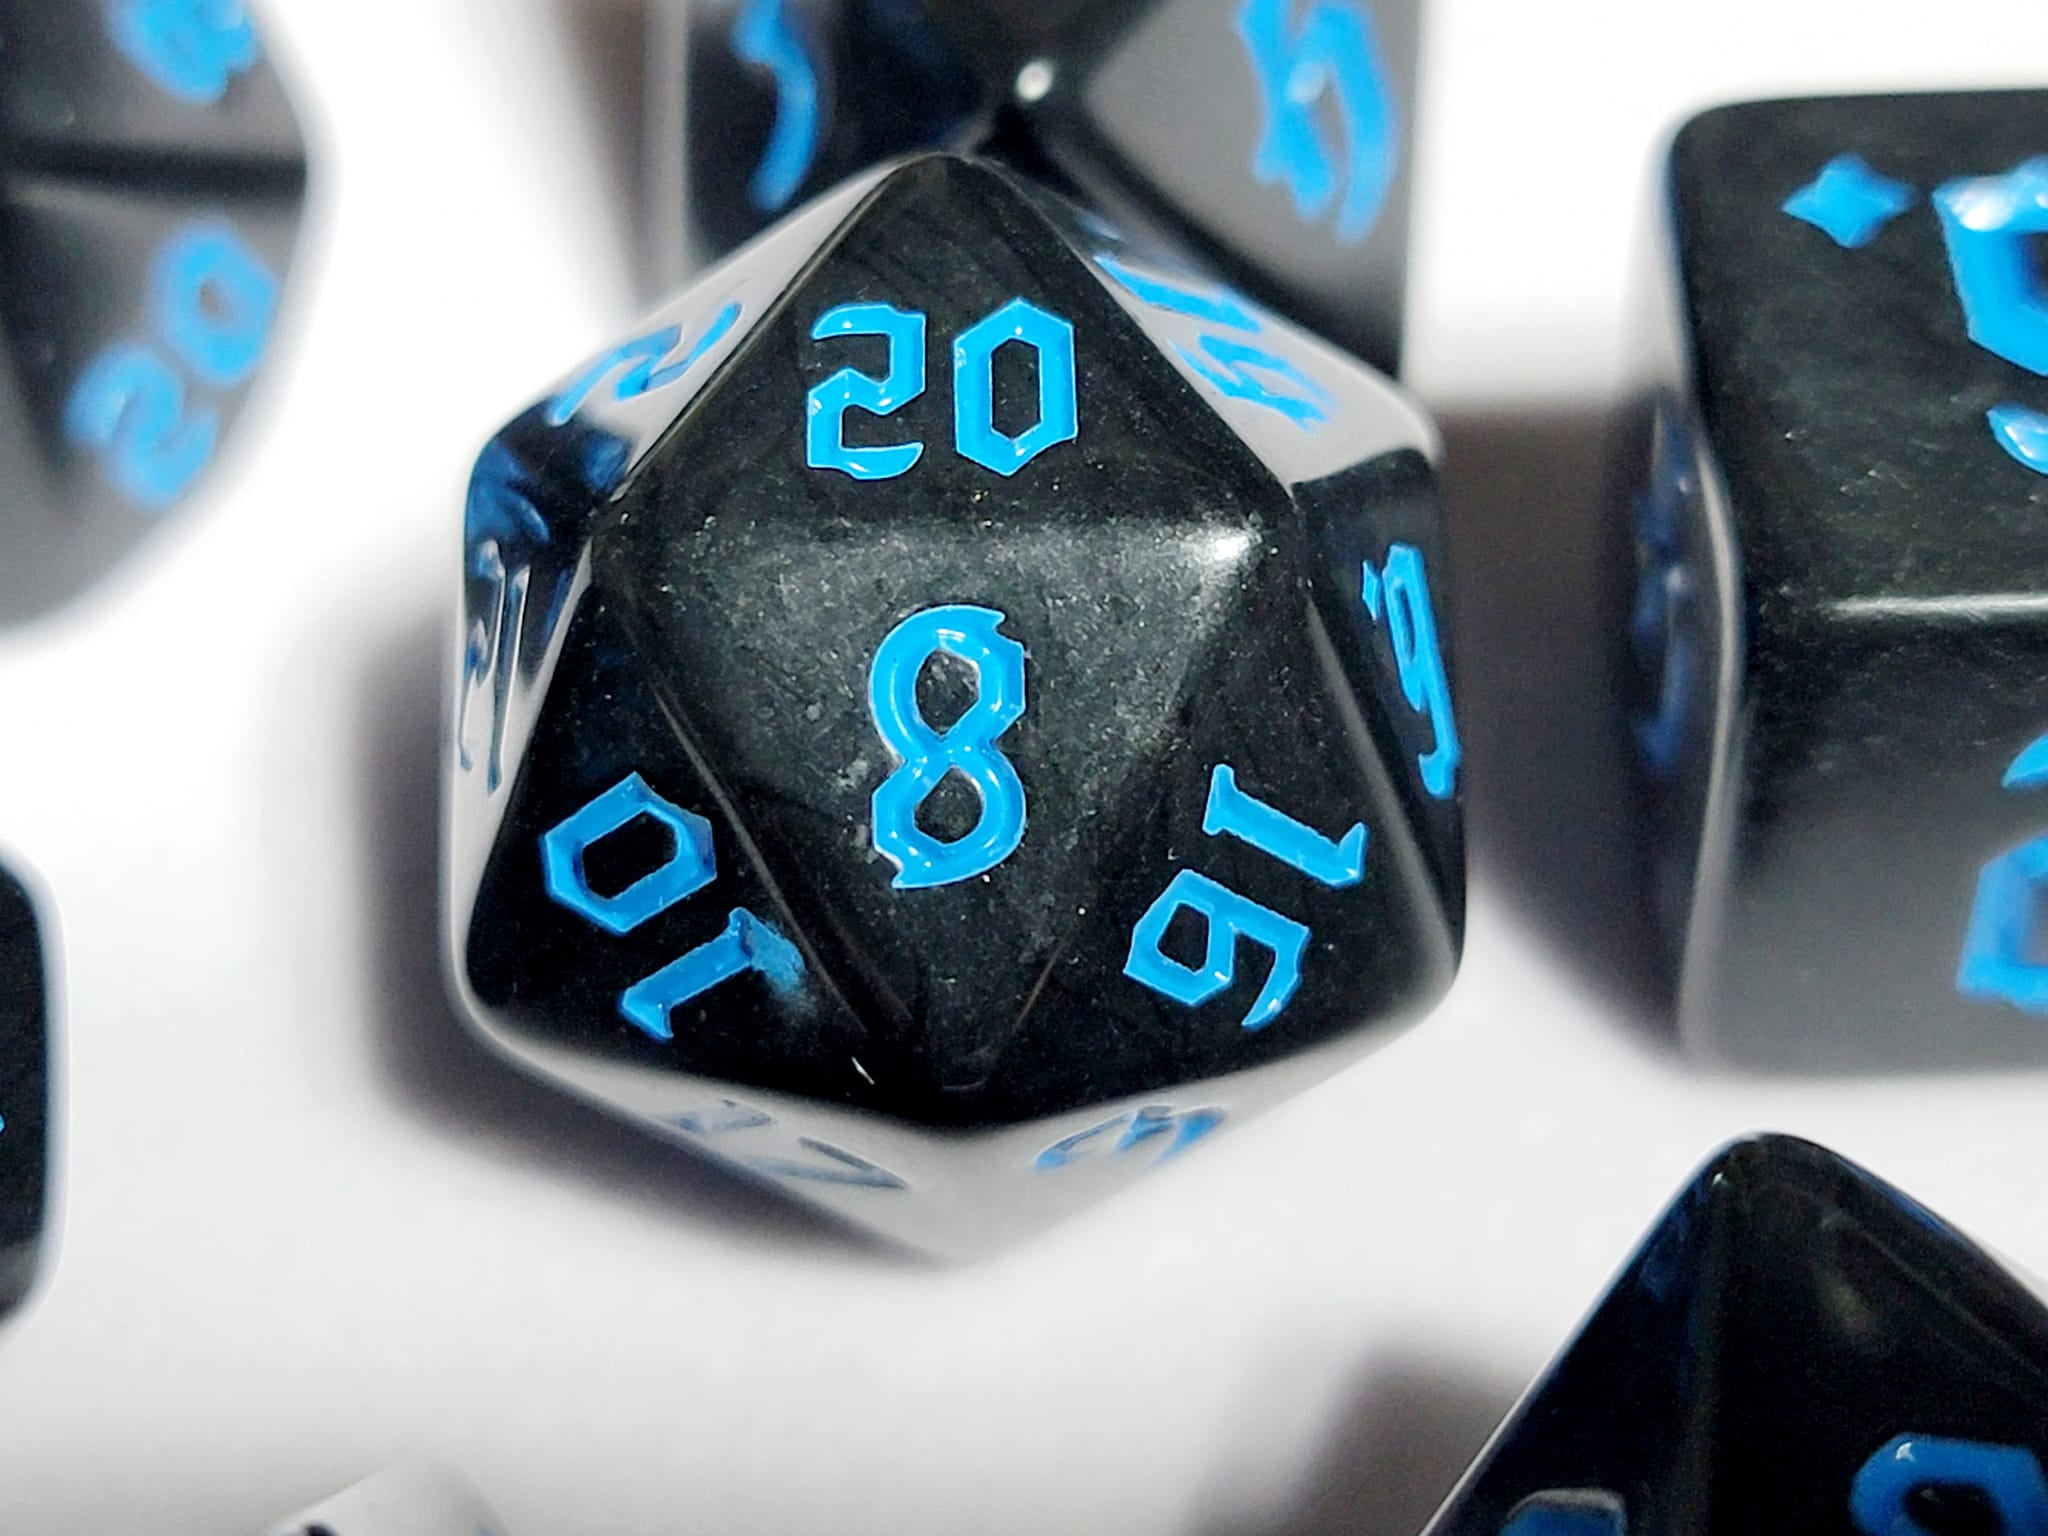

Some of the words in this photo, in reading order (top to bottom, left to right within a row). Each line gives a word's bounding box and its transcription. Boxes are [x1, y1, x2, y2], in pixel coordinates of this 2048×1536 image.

[804, 297, 1081, 481] 20
[868, 604, 1027, 892] 8
[540, 771, 758, 1041] 10
[1122, 763, 1368, 1031] 16
